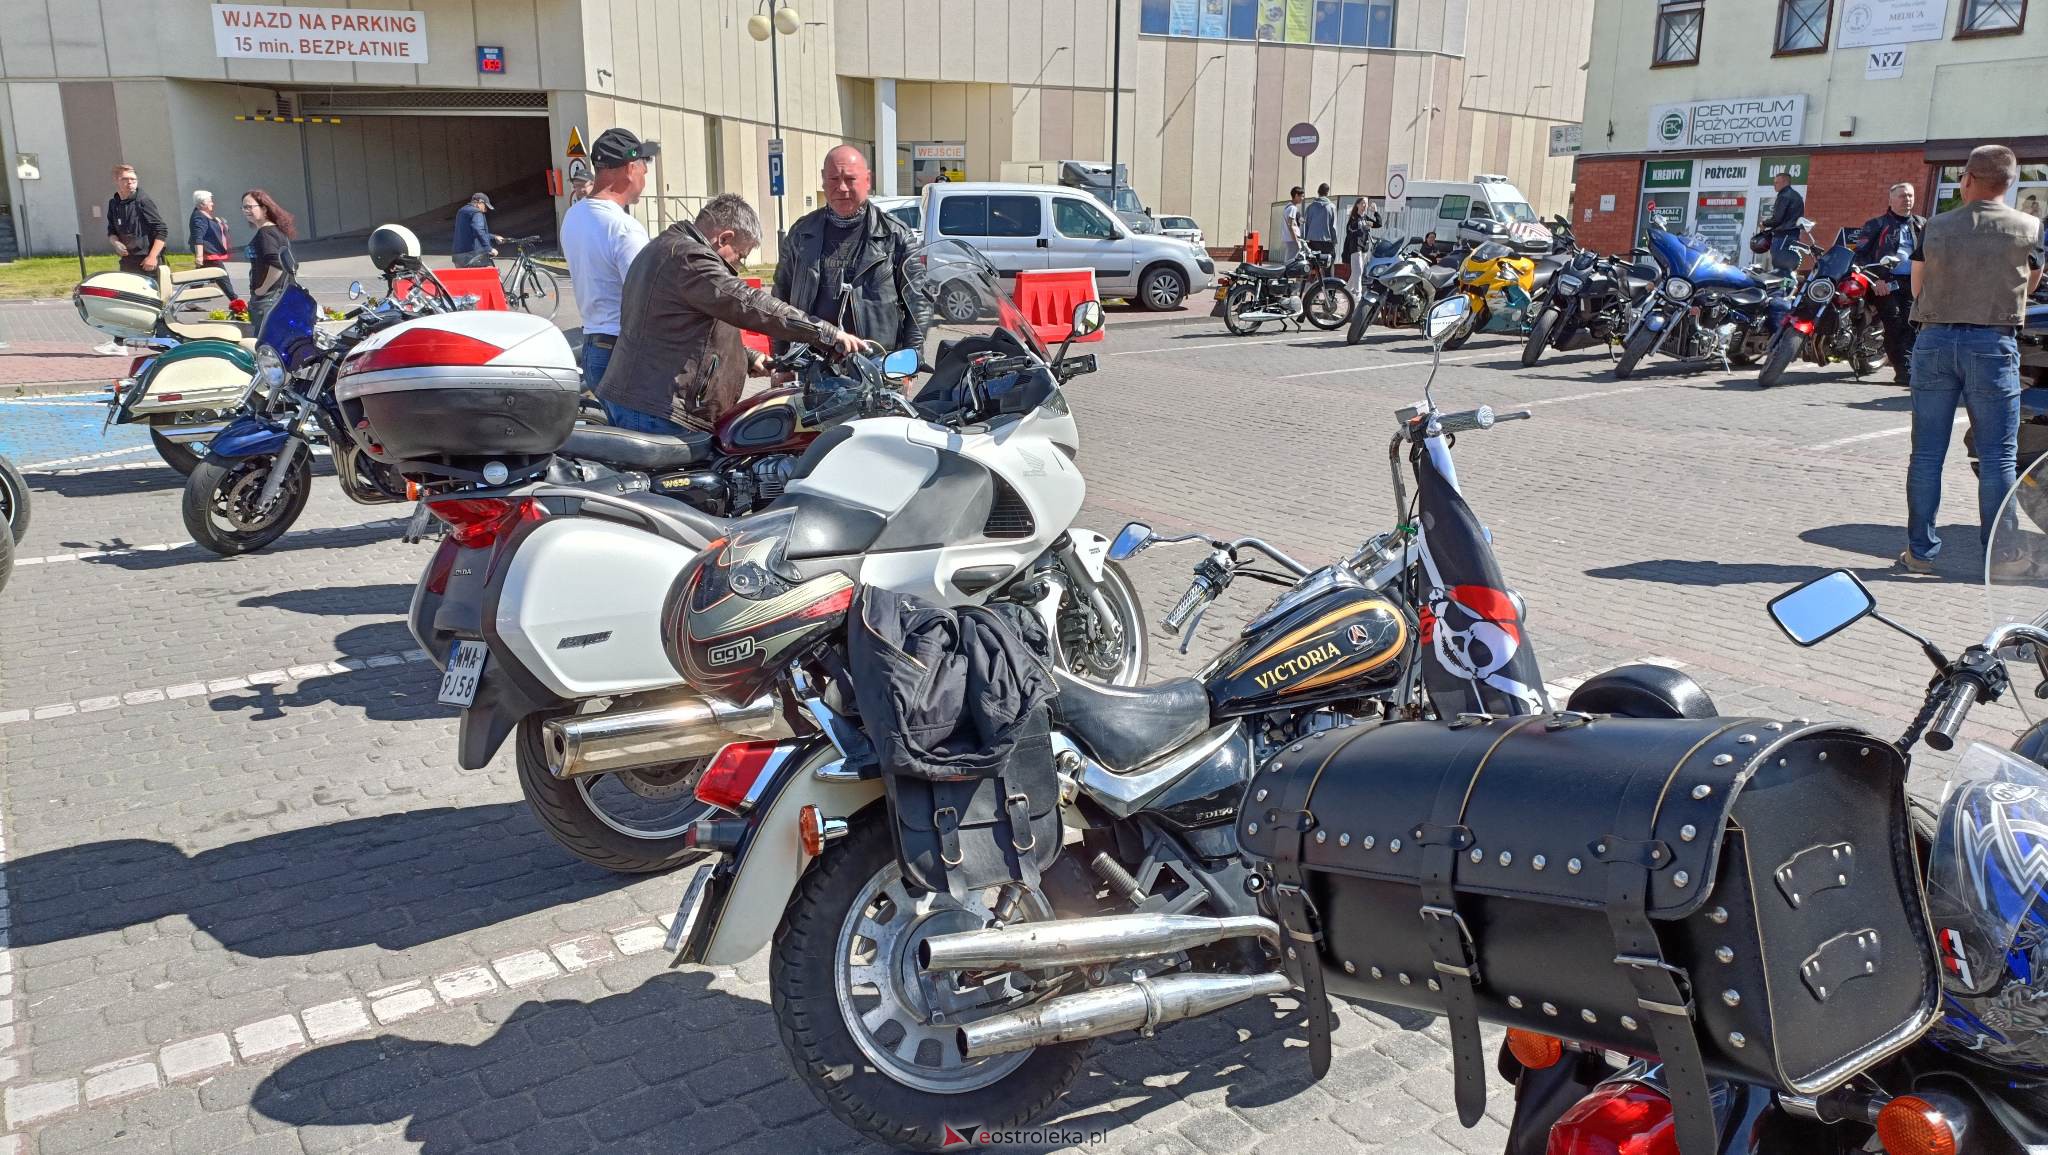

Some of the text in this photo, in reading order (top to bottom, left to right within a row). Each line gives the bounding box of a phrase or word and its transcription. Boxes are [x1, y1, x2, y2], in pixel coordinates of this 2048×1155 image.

[222, 10, 417, 33] WJAZD NA PARKING
[234, 36, 409, 57] 15 min. BEZPŁATNIE
[1697, 100, 1794, 117] CENTRUM
[1695, 115, 1793, 131] POŻYCZKOWO
[1694, 130, 1792, 145] KREDYTOWE
[1652, 168, 1685, 180] KREDYTY
[1704, 165, 1748, 179] POŻYCZKI
[662, 478, 690, 488] W650
[713, 643, 748, 663] agv
[1254, 641, 1342, 689] VICTORIA
[441, 675, 475, 698] 9J58
